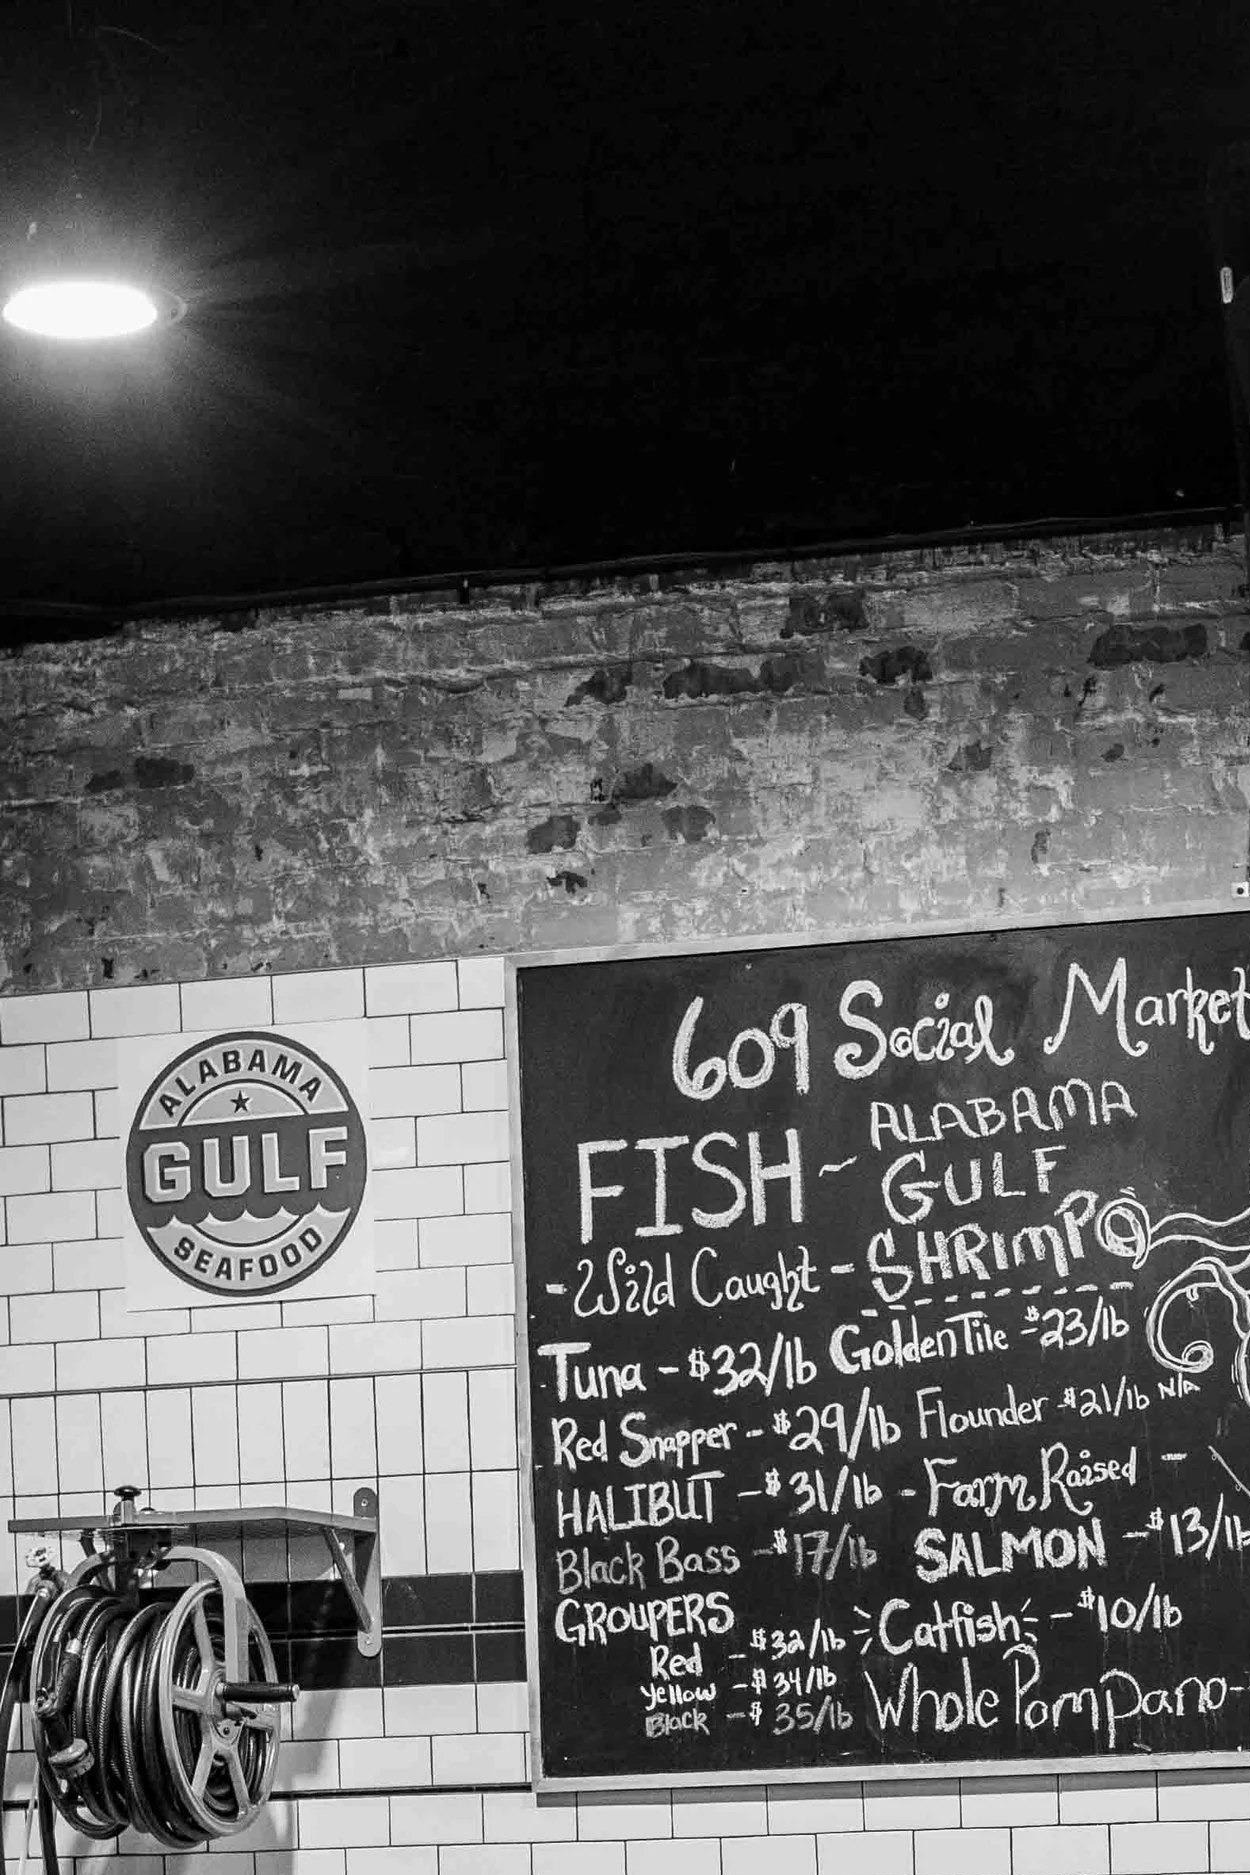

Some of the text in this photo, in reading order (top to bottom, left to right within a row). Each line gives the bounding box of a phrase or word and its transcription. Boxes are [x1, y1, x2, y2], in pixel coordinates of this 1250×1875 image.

[672, 996, 810, 1101] 609
[833, 980, 1015, 1080] Social
[159, 1049, 322, 1117] ALABAMA
[870, 1078, 1138, 1151] ALABAMA
[141, 1127, 348, 1203] GULF
[577, 1128, 805, 1244] FISH
[881, 1145, 1066, 1225] GULF
[174, 1227, 322, 1280] SEAFOOD
[866, 1189, 1098, 1302] SHRIMP
[574, 1247, 675, 1317] Wild
[691, 1245, 820, 1312] Caught
[538, 1342, 647, 1402] Tuna
[829, 1315, 957, 1374] Golden
[949, 1311, 1009, 1355] Tile
[551, 1418, 608, 1470] Red
[619, 1411, 737, 1469] Snapper
[916, 1384, 1049, 1439] Flounder
[557, 1470, 725, 1538] HALIBUT
[923, 1458, 1037, 1517] Farm
[1039, 1442, 1136, 1516] Raised
[556, 1542, 645, 1594] Black
[656, 1536, 740, 1583] Bass
[914, 1517, 1106, 1583] SALMON
[555, 1592, 734, 1646] GROUPERS
[879, 1598, 1027, 1655] Catfish
[650, 1642, 703, 1680] Red
[864, 1657, 999, 1732] Whole
[646, 1708, 710, 1737] Black
